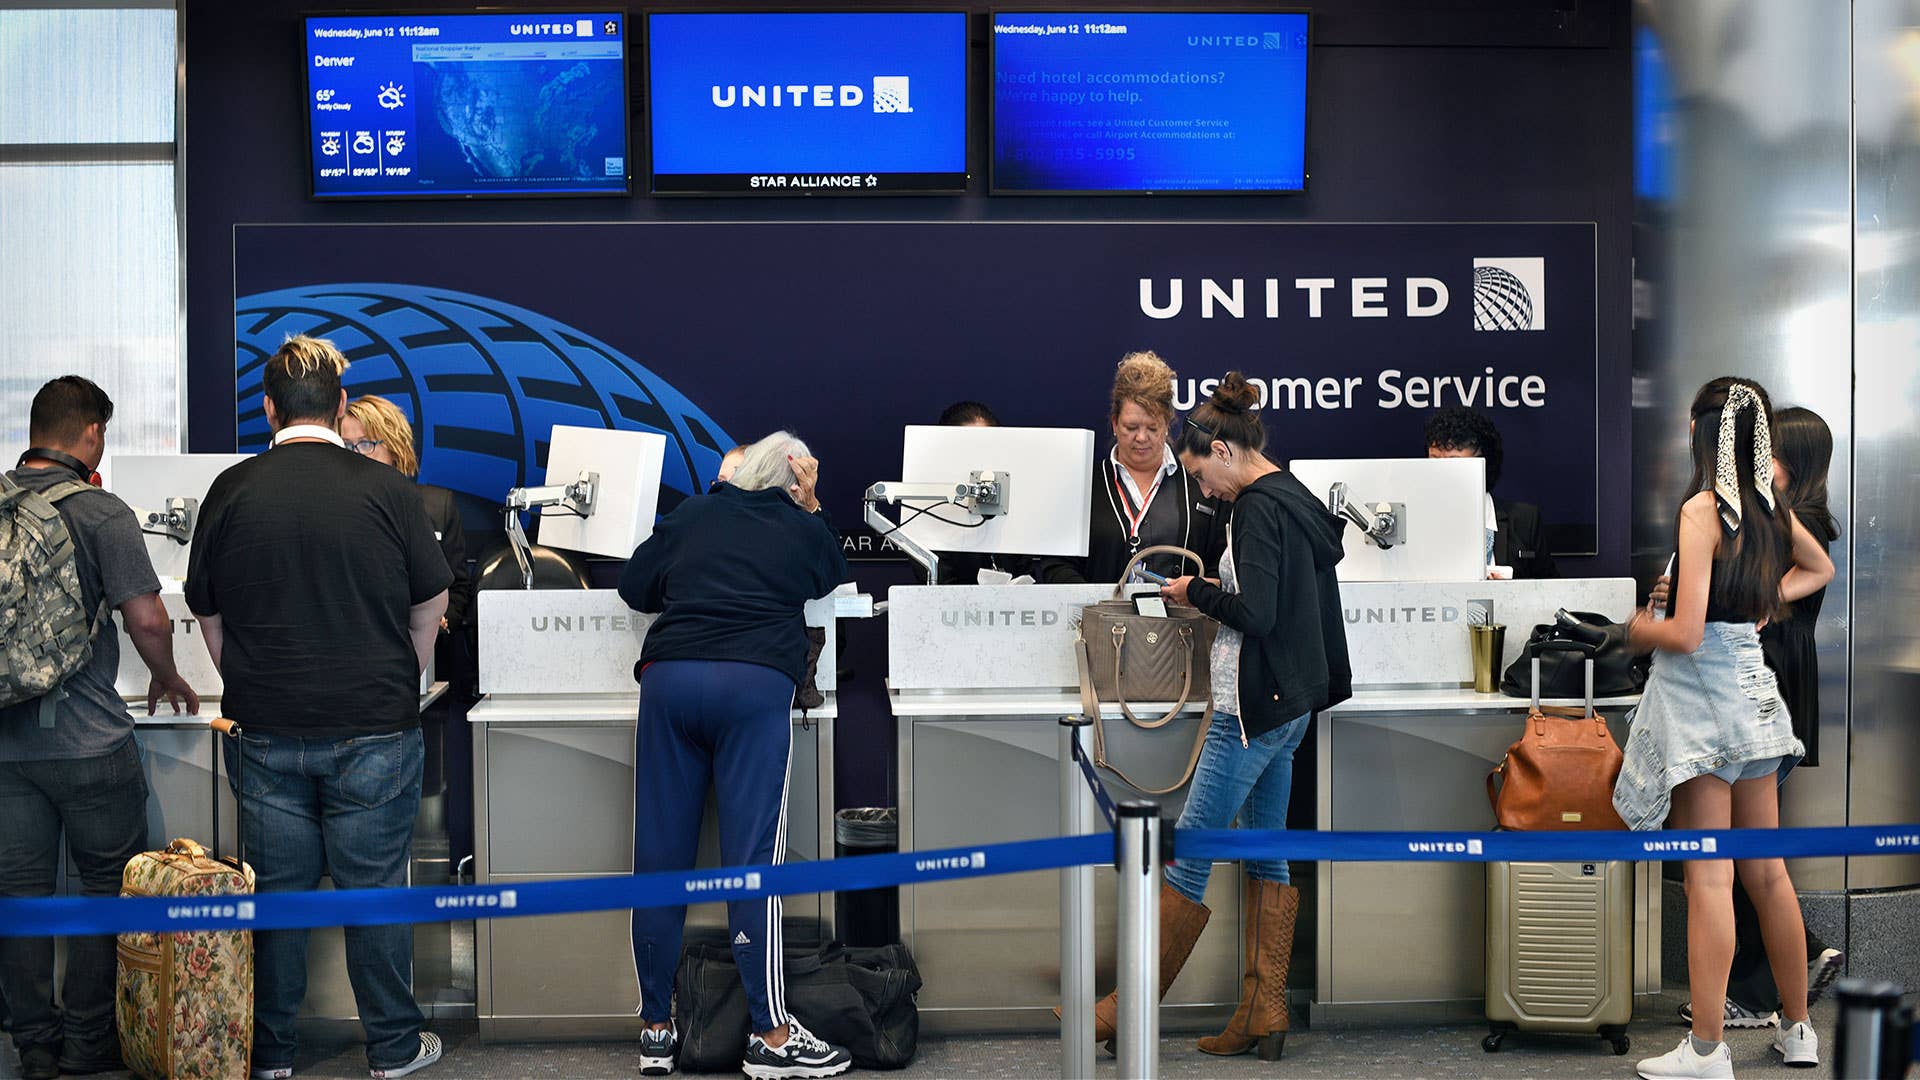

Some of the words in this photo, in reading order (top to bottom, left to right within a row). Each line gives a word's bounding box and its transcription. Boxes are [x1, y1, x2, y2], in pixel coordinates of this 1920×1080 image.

[314, 27, 363, 39] Wednesday,
[363, 27, 382, 38] June
[384, 27, 395, 36] 12
[399, 26, 440, 36] 11:12am
[510, 24, 574, 35] UNITED
[994, 24, 1045, 35] Wednesday,
[1046, 24, 1066, 35] June
[1068, 24, 1079, 34] 12
[1084, 23, 1128, 34] 11:12am
[1187, 36, 1259, 47] UNITED
[314, 55, 355, 67] Denver
[997, 71, 1036, 84] Need
[1042, 71, 1081, 84] hotel
[1086, 71, 1226, 84] accommodations?
[316, 89, 335, 101] 65°
[712, 85, 864, 107] UNITED
[1041, 89, 1086, 104] happy
[1089, 91, 1104, 102] to
[1108, 89, 1143, 104] help.
[1114, 119, 1145, 127] United
[1148, 119, 1193, 128] Customer
[1195, 119, 1230, 128] Service
[1105, 131, 1138, 141] Airport
[1140, 131, 1221, 140] Accommodations
[750, 176, 786, 187] STAR
[791, 175, 861, 187] ALLIANCE
[1140, 277, 1450, 319] UNITED
[1171, 372, 1362, 410] usomer
[1379, 367, 1546, 408] Service
[941, 610, 1059, 627] UNITED
[1344, 606, 1459, 624] UNITED
[531, 615, 650, 632] UNITED
[1408, 842, 1466, 854] UNITED
[1643, 841, 1700, 852] UNITED
[915, 855, 970, 872] UNITED
[685, 877, 745, 892] UNITED
[436, 895, 499, 909] UNITED
[168, 904, 236, 919] UNITED
